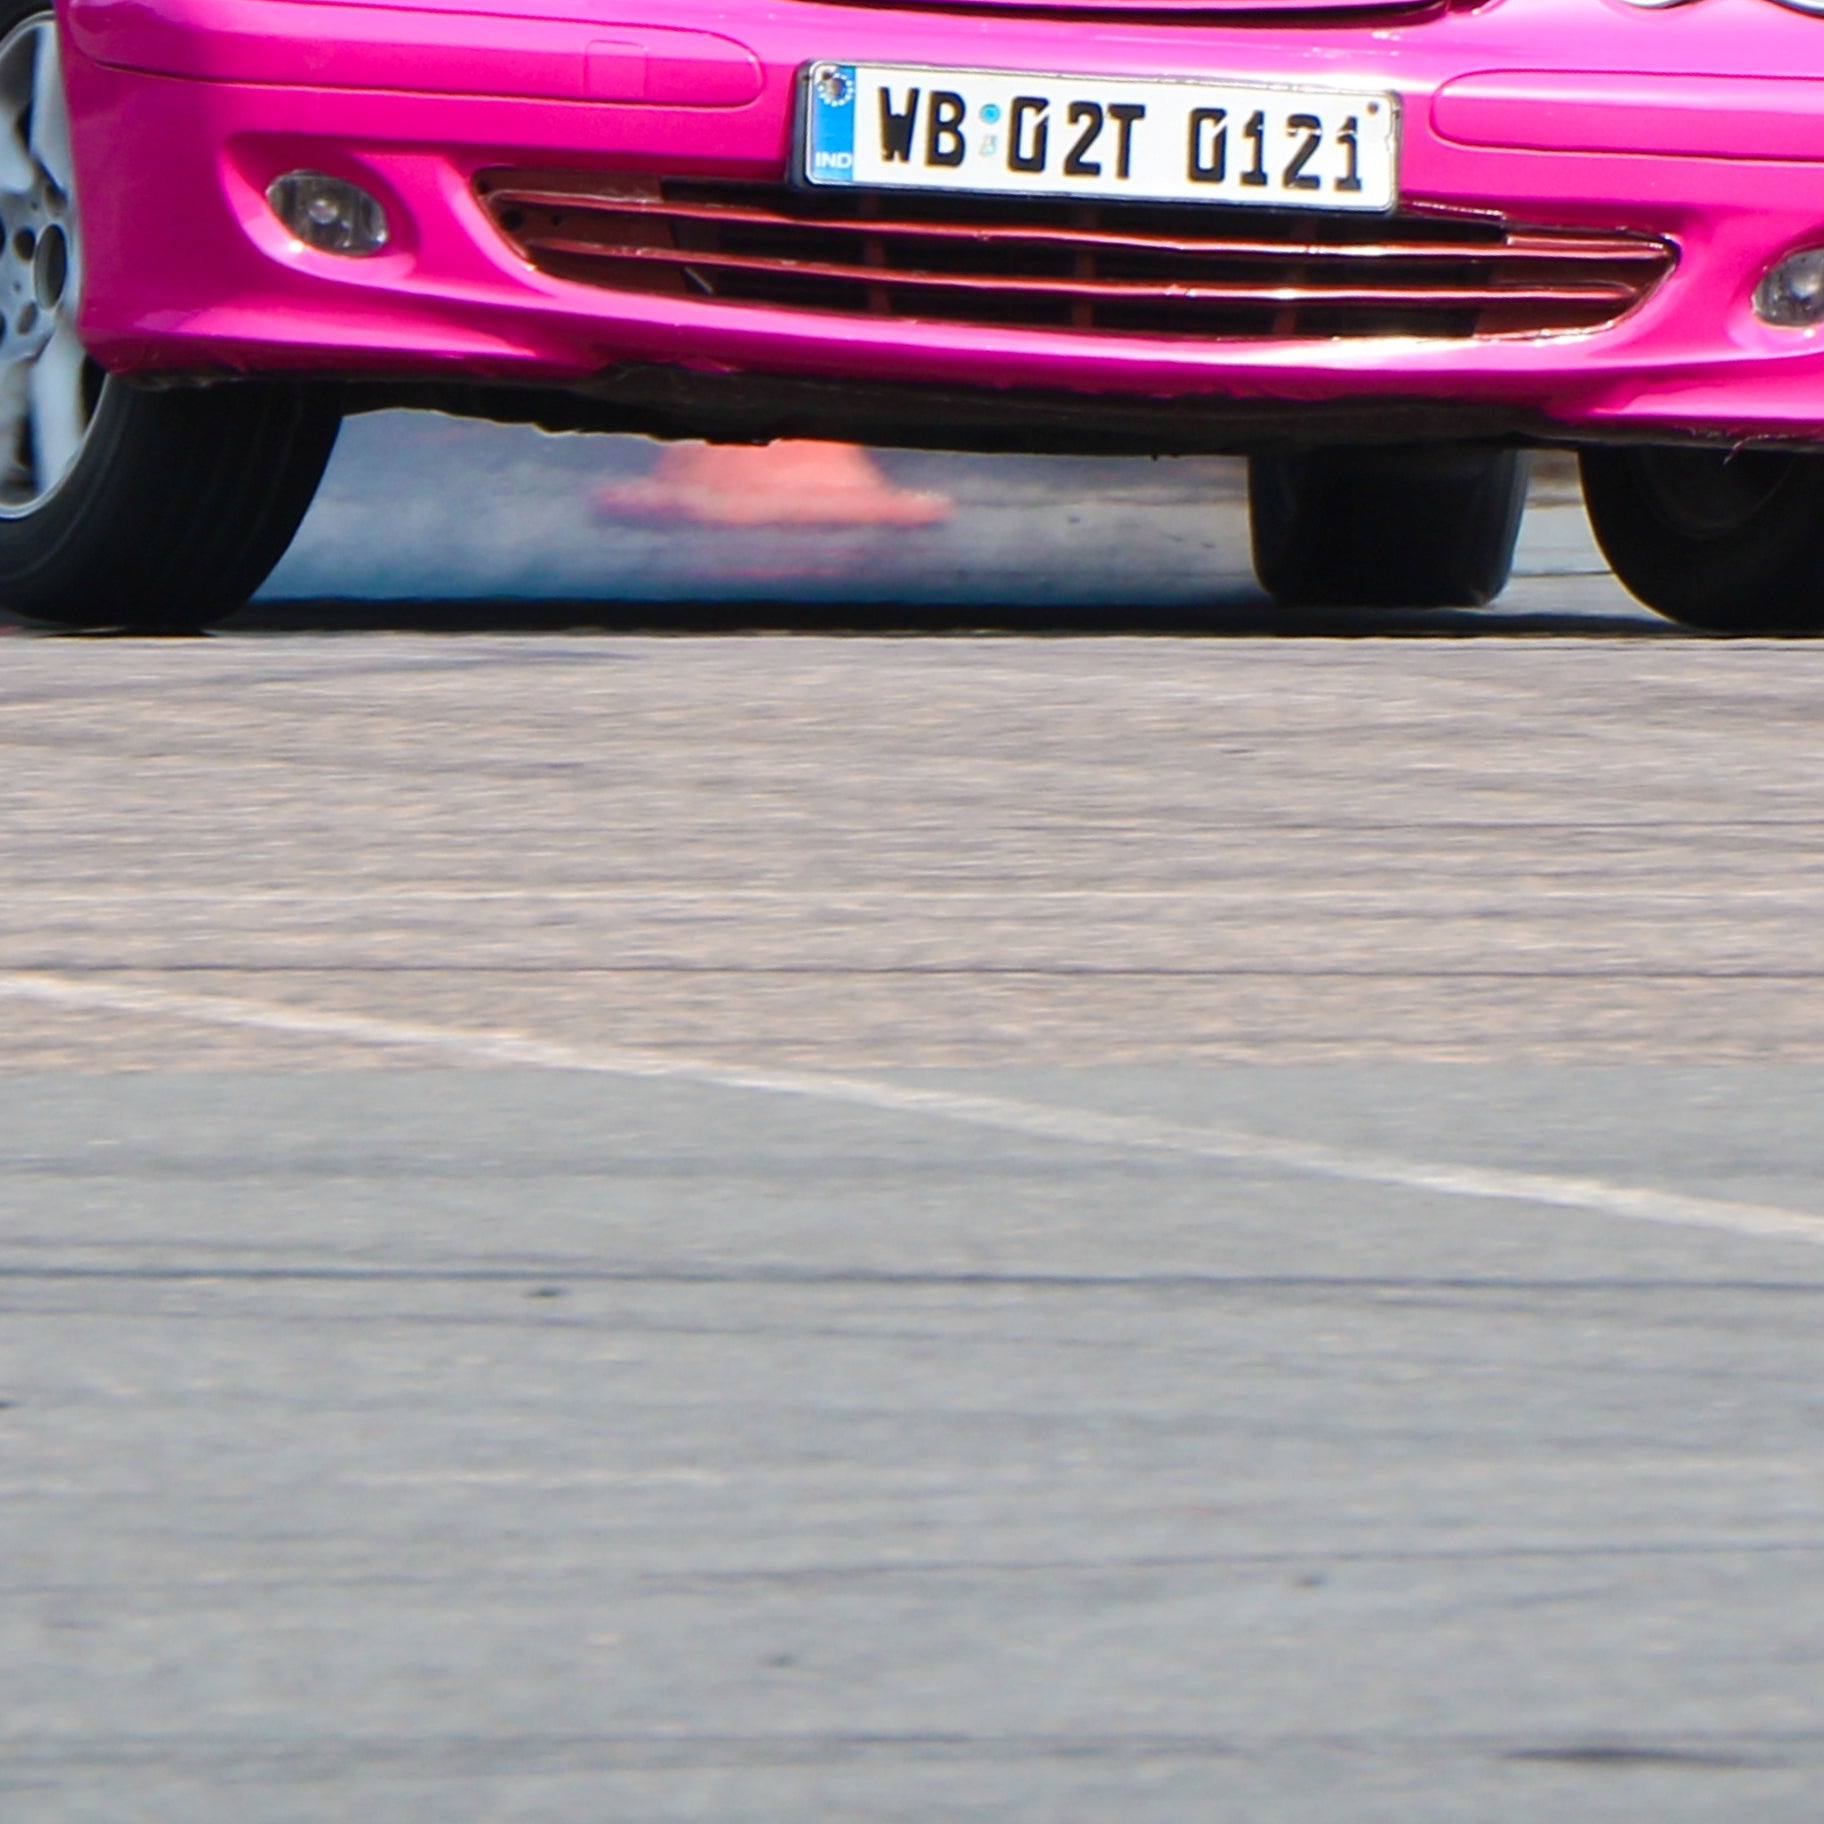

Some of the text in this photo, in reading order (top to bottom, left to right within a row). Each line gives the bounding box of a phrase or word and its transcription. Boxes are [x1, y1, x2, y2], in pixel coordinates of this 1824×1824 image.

[815, 150, 853, 169] IND
[878, 86, 967, 169] WB
[1186, 106, 1364, 193] 0121
